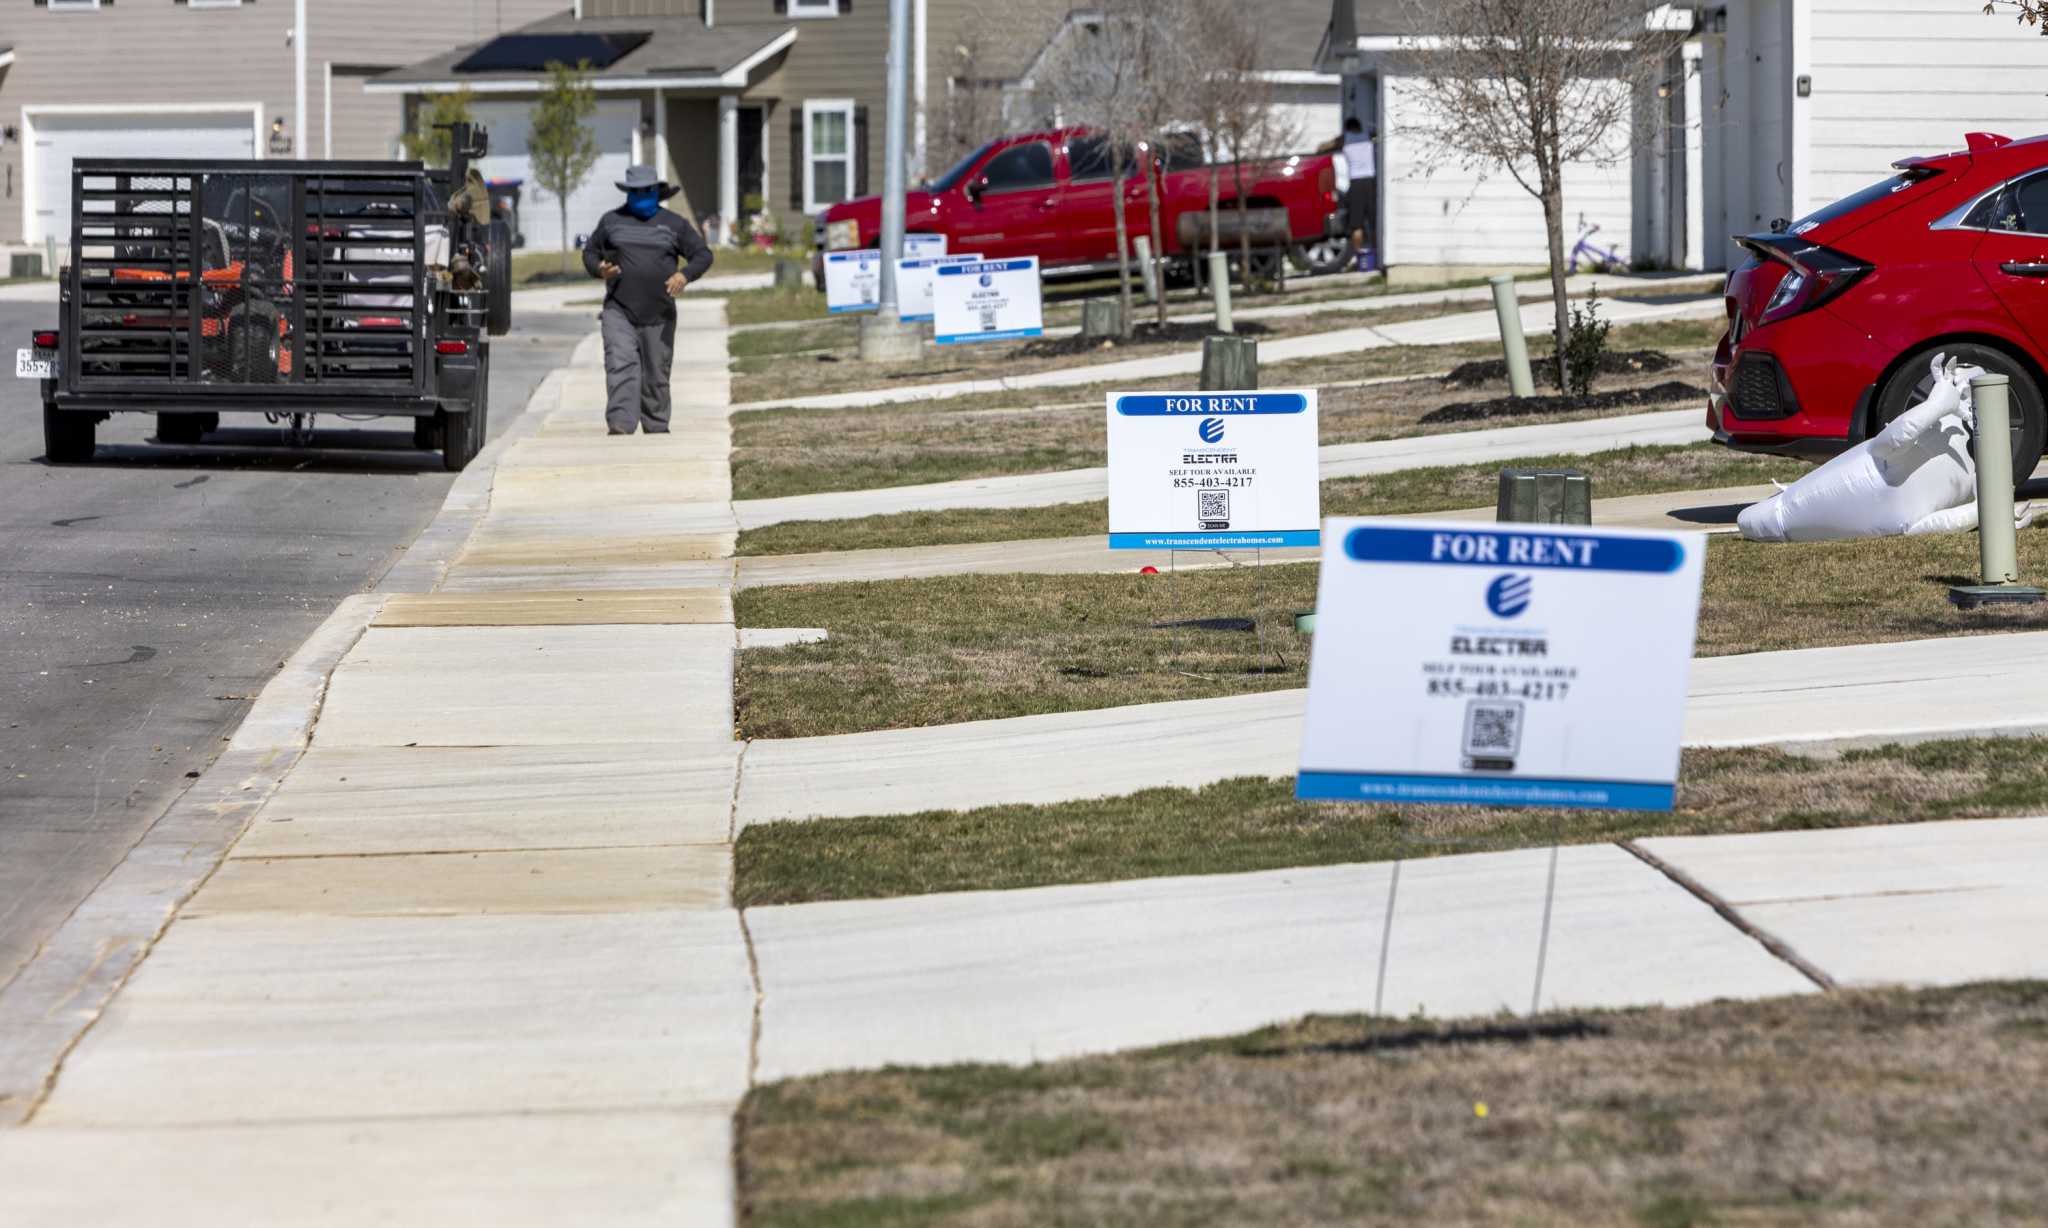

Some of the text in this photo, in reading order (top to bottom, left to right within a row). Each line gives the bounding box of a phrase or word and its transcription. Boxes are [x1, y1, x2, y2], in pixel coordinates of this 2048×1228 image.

[1165, 397, 1258, 412] FOR RENT
[1183, 454, 1237, 464] ELECTRA
[1173, 477, 1253, 488] 855-403-4217
[1145, 536, 1284, 545] www.transcendentelectrahomes.com
[1431, 533, 1600, 566] FOR RENT
[1450, 636, 1548, 656] ELECTRA
[1427, 679, 1570, 701] 855-403-4217
